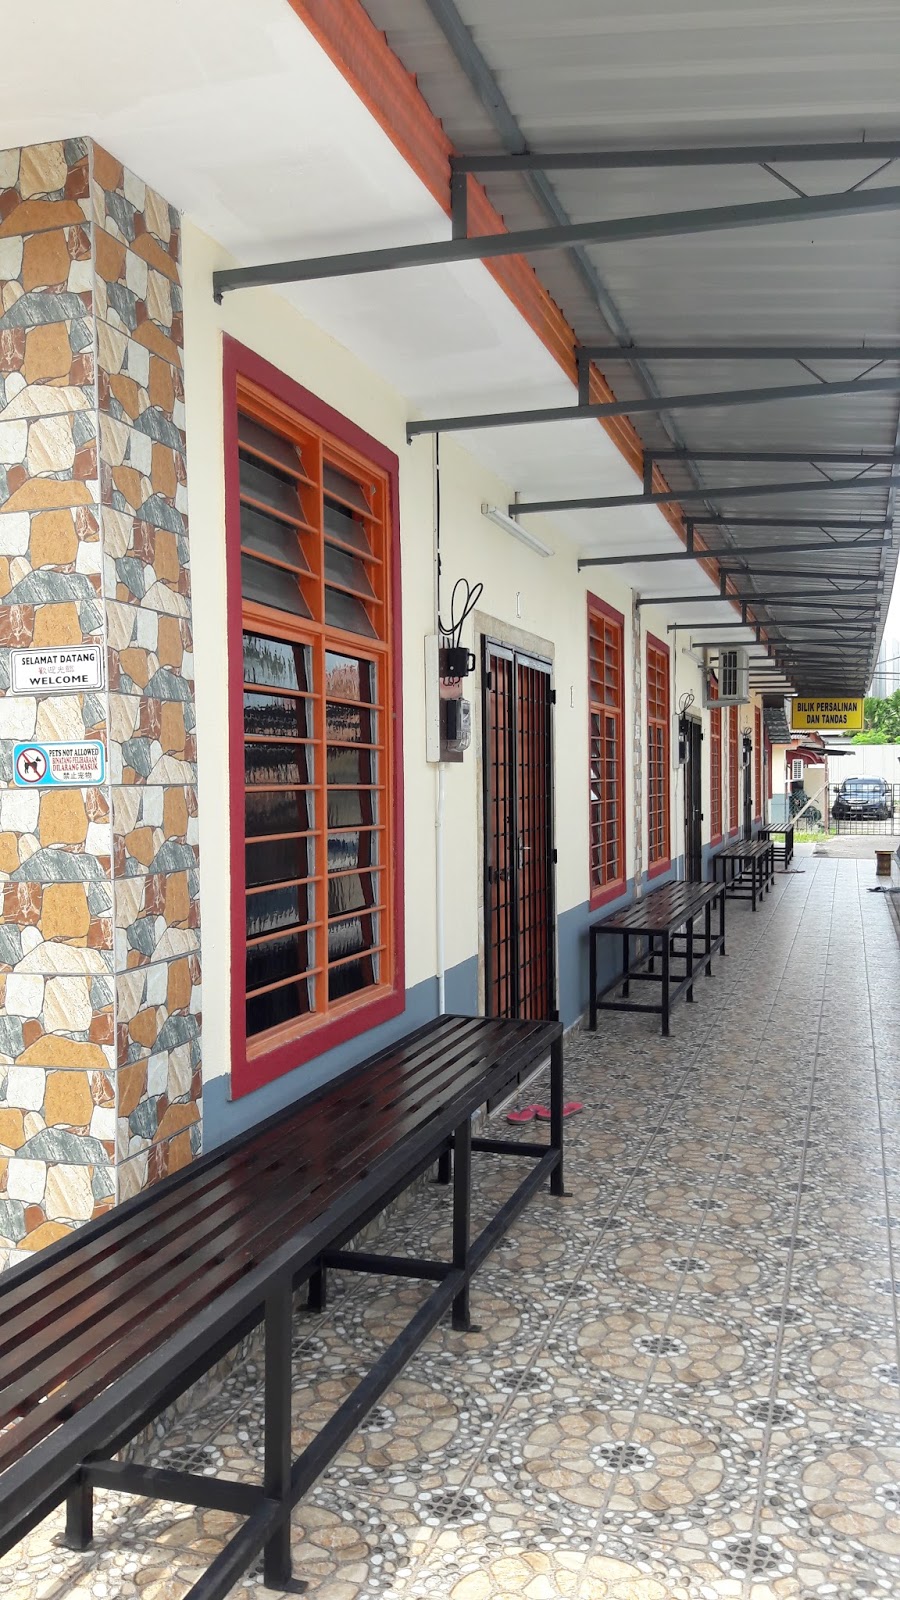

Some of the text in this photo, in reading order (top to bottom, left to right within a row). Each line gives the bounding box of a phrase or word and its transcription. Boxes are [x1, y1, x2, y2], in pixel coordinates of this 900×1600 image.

[22, 653, 95, 665] SELAMAT DATANG
[29, 675, 88, 685] WELCOME
[797, 702, 858, 712] BILIK PERSALINAN
[806, 714, 847, 724] DAN TANDAS
[49, 749, 61, 757] PETS
[74, 748, 99, 756] ALLOWED
[80, 763, 98, 771] MASUK
